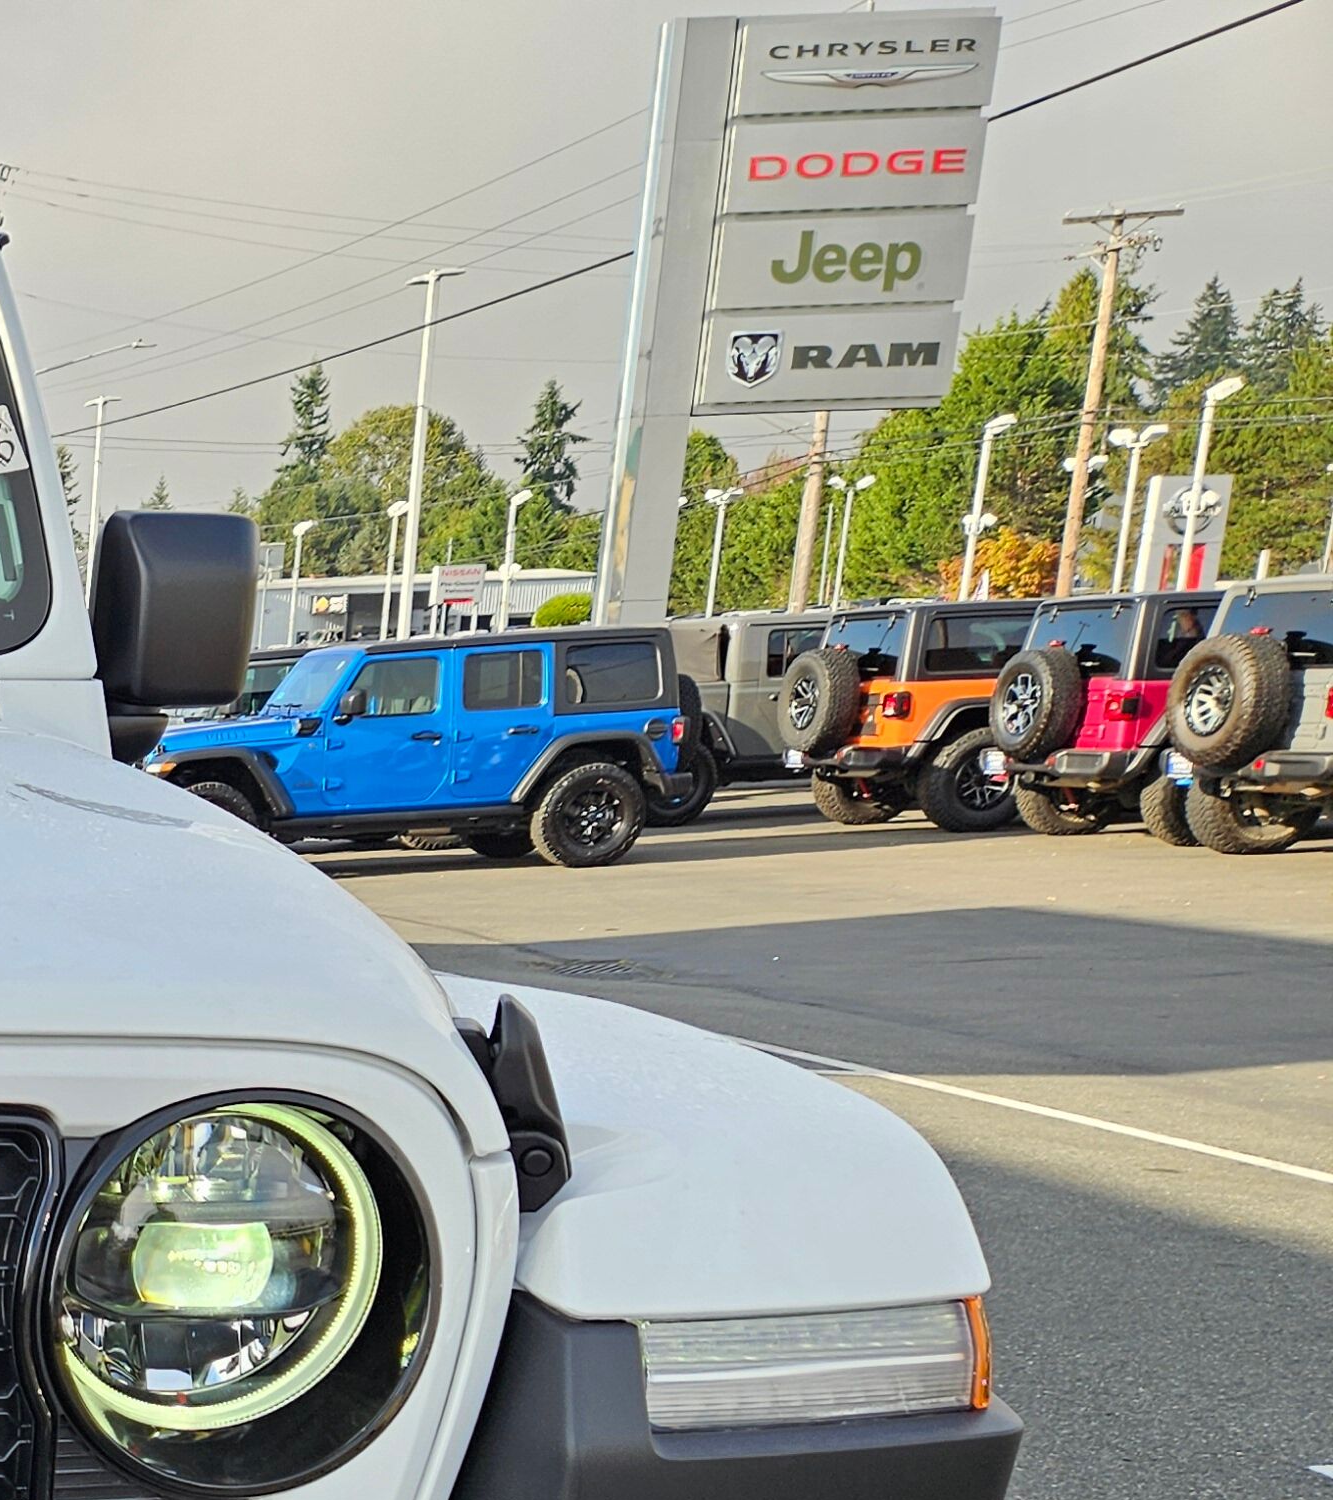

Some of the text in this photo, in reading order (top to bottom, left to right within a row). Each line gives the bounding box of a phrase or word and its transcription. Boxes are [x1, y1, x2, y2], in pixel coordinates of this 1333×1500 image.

[769, 38, 977, 59] CHRYSLER
[748, 148, 967, 182] DODGE
[770, 230, 923, 292] Jeep
[790, 342, 941, 370] RAM
[441, 568, 481, 577] NISSAN
